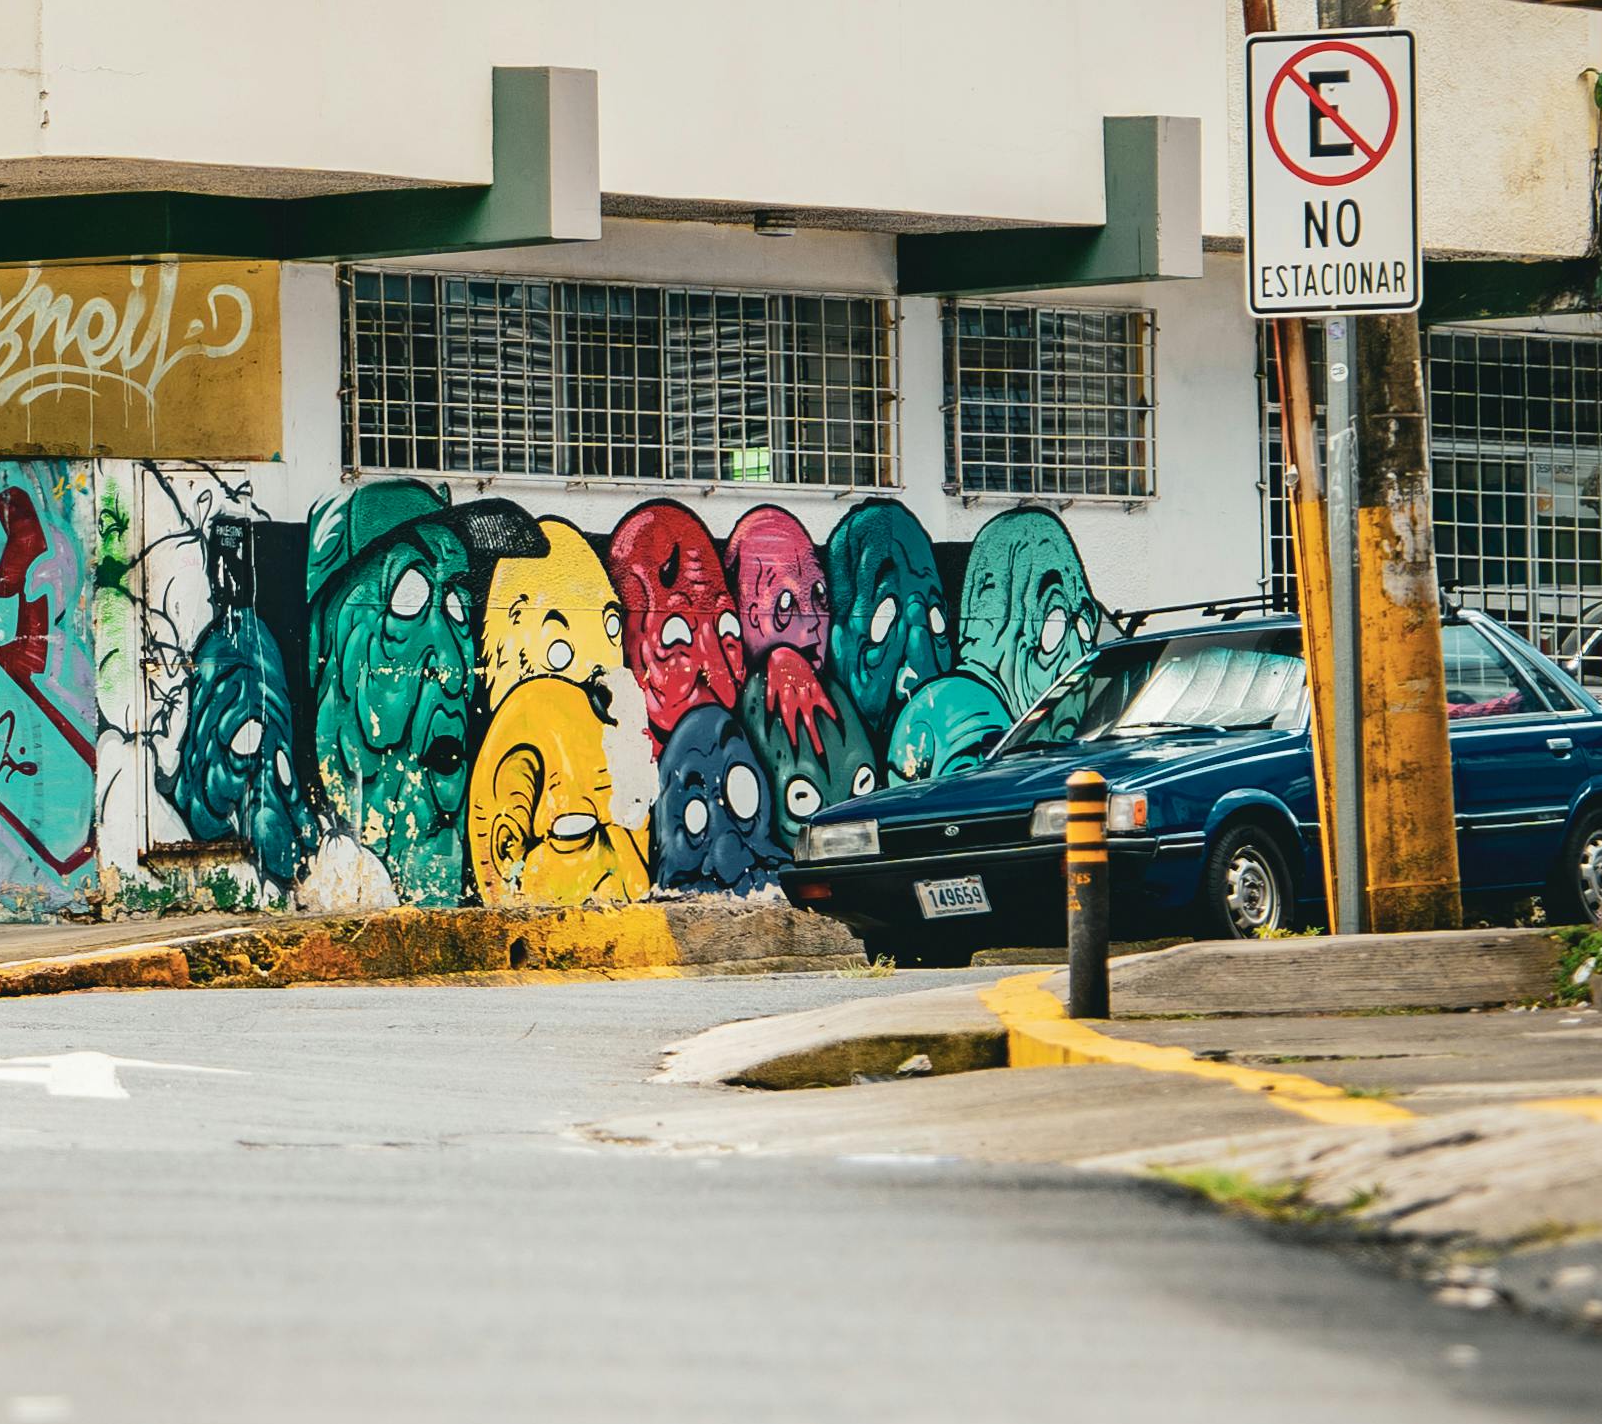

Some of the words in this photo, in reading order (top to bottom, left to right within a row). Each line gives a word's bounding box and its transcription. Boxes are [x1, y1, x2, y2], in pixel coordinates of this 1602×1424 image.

[1304, 198, 1362, 249] NO
[1261, 261, 1407, 298] ESTACIONAR
[928, 886, 983, 908] 149659
